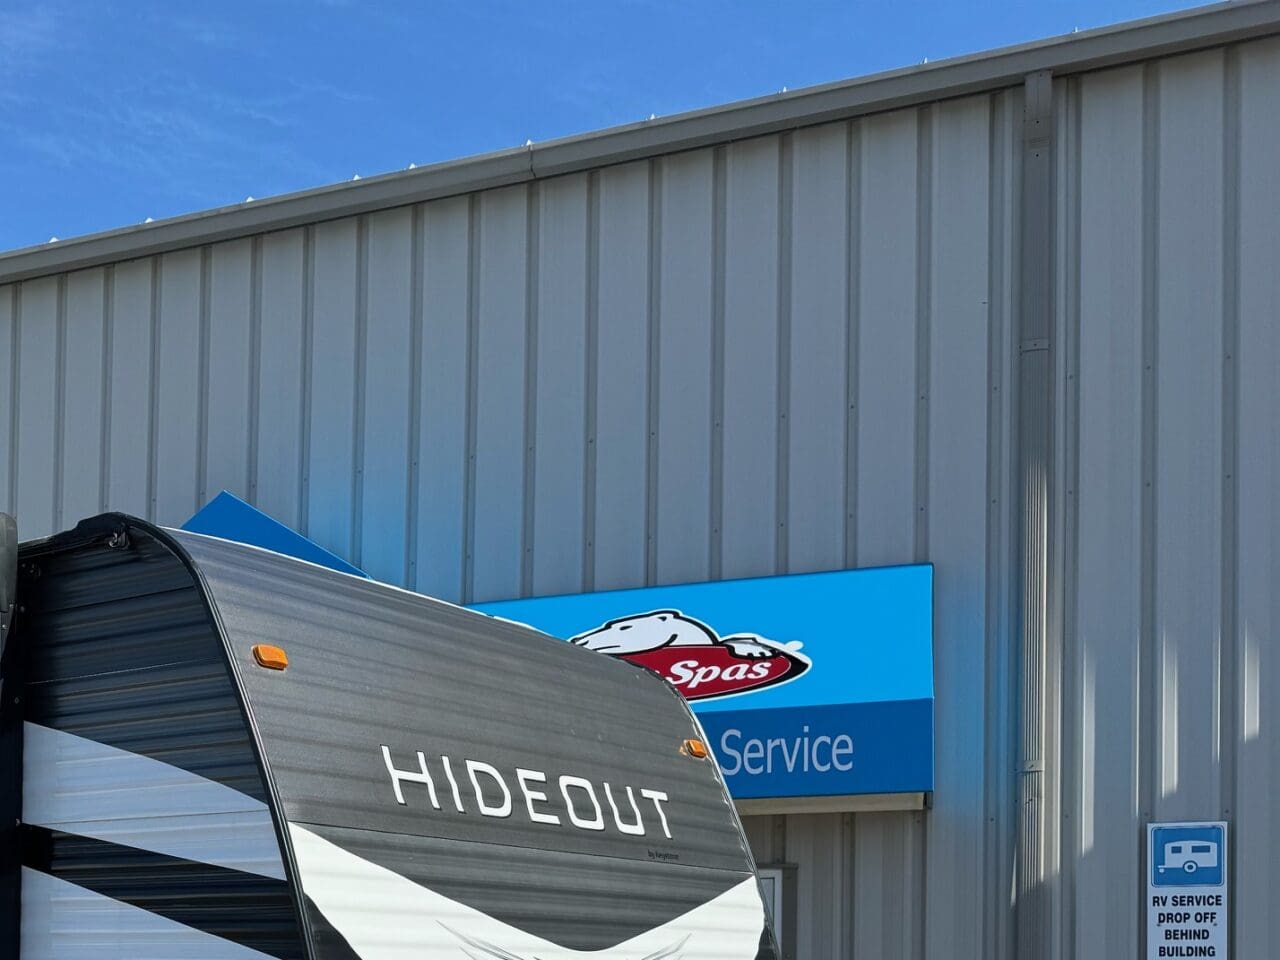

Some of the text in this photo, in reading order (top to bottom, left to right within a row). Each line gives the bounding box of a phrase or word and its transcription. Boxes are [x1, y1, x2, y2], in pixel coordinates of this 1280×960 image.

[665, 660, 772, 688] Spas
[720, 725, 854, 776] Service
[380, 744, 673, 839] HIDEOUT
[1152, 894, 1222, 907] RV SERVICE
[1157, 912, 1217, 924] DROP OFF
[1164, 929, 1210, 940] BEHIND
[1158, 946, 1216, 957] BUILDING
